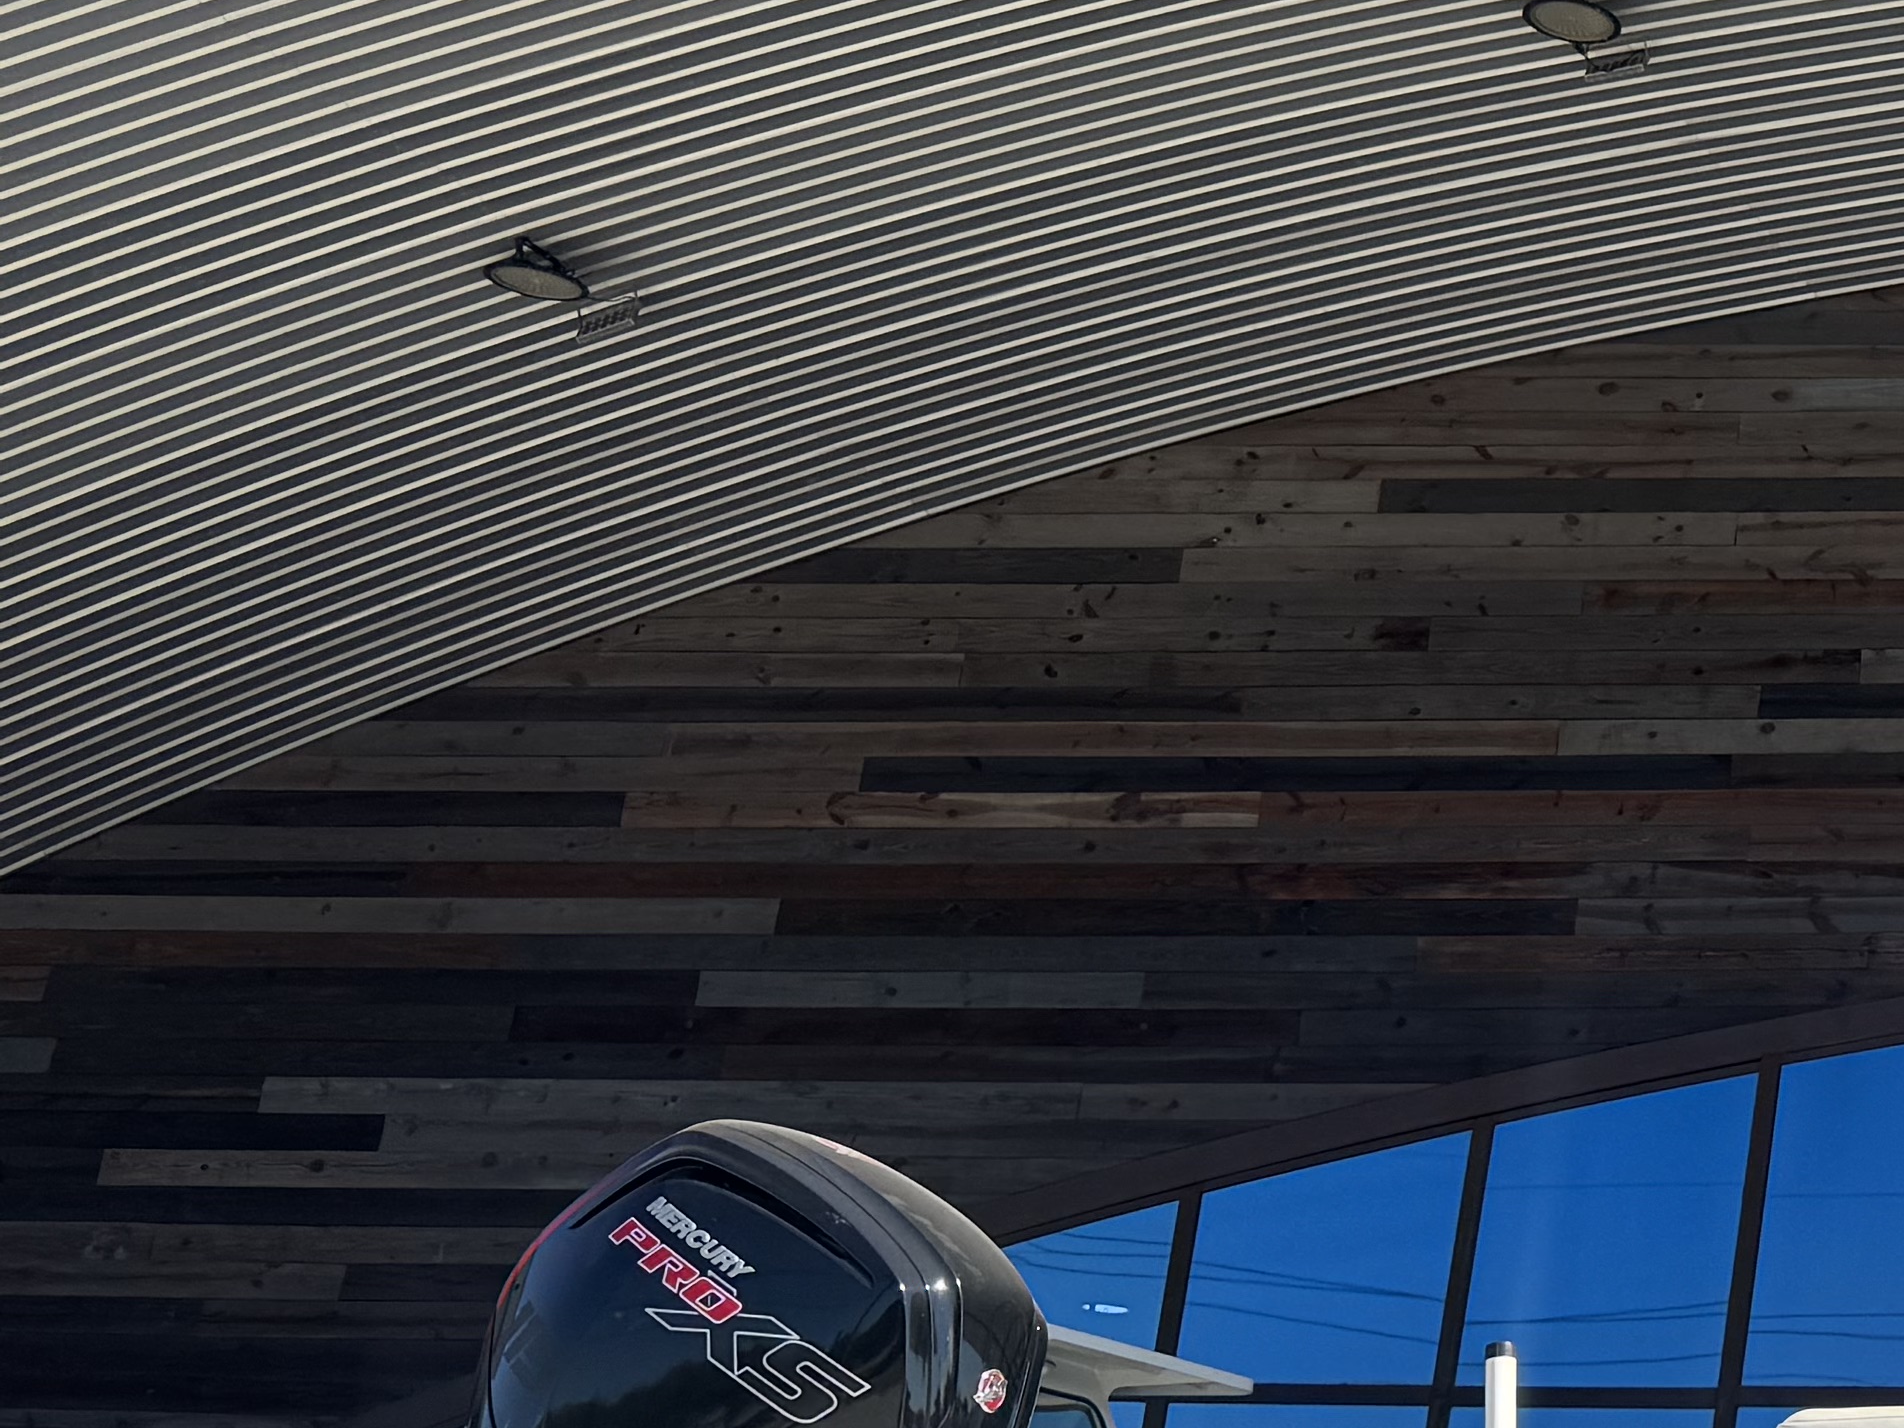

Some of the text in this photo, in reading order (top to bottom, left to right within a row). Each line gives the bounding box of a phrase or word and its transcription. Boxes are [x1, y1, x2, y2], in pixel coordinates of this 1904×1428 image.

[608, 1216, 743, 1324] PRO
[645, 1195, 757, 1279] MERCURY
[644, 1272, 872, 1424] XS
